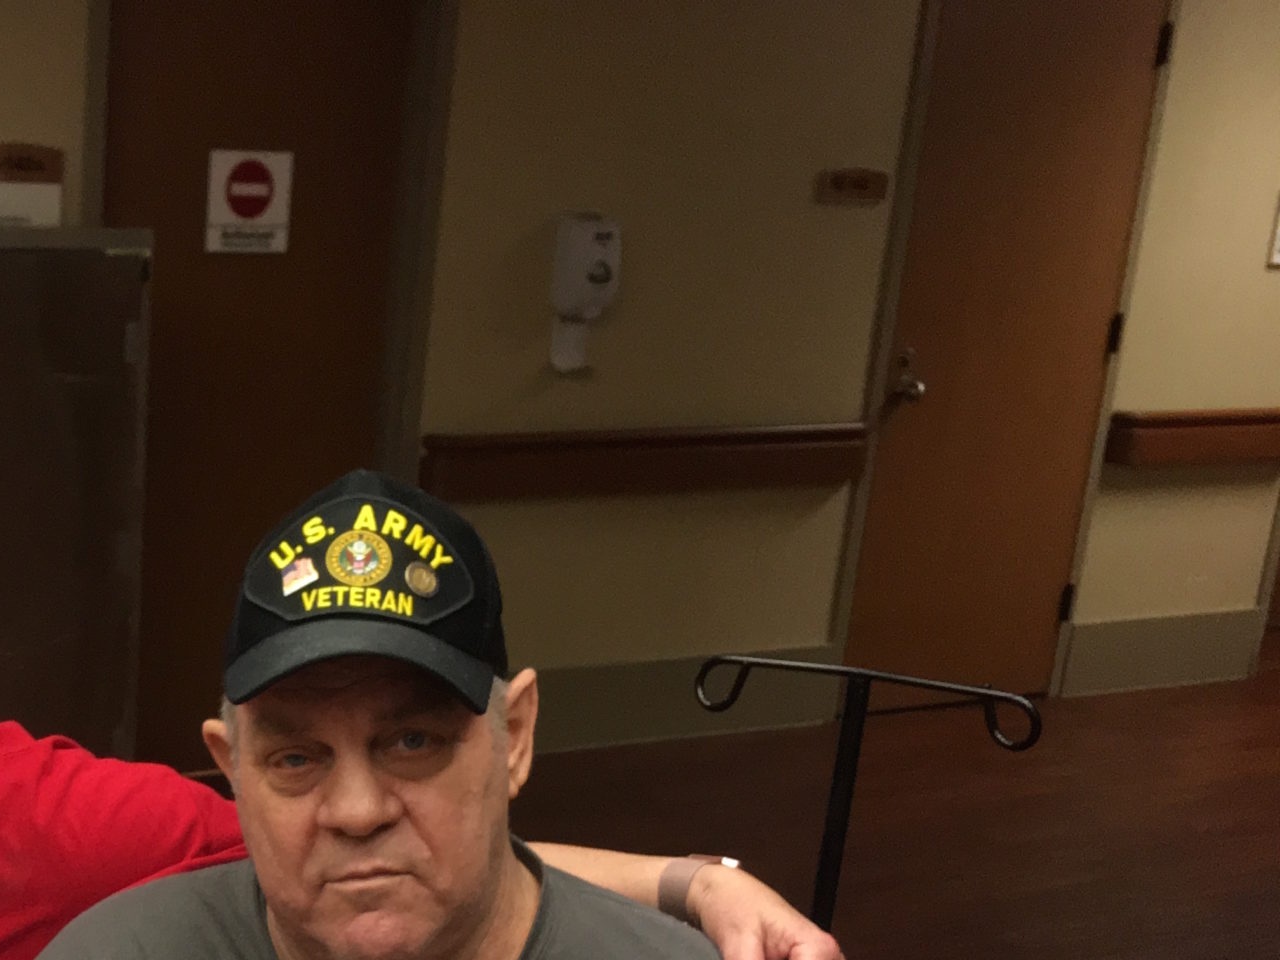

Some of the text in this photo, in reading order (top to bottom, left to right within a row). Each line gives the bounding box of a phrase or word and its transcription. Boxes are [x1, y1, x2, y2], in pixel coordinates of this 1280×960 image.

[269, 504, 454, 570] U.S. ARMY
[302, 586, 414, 616] VETERAN
